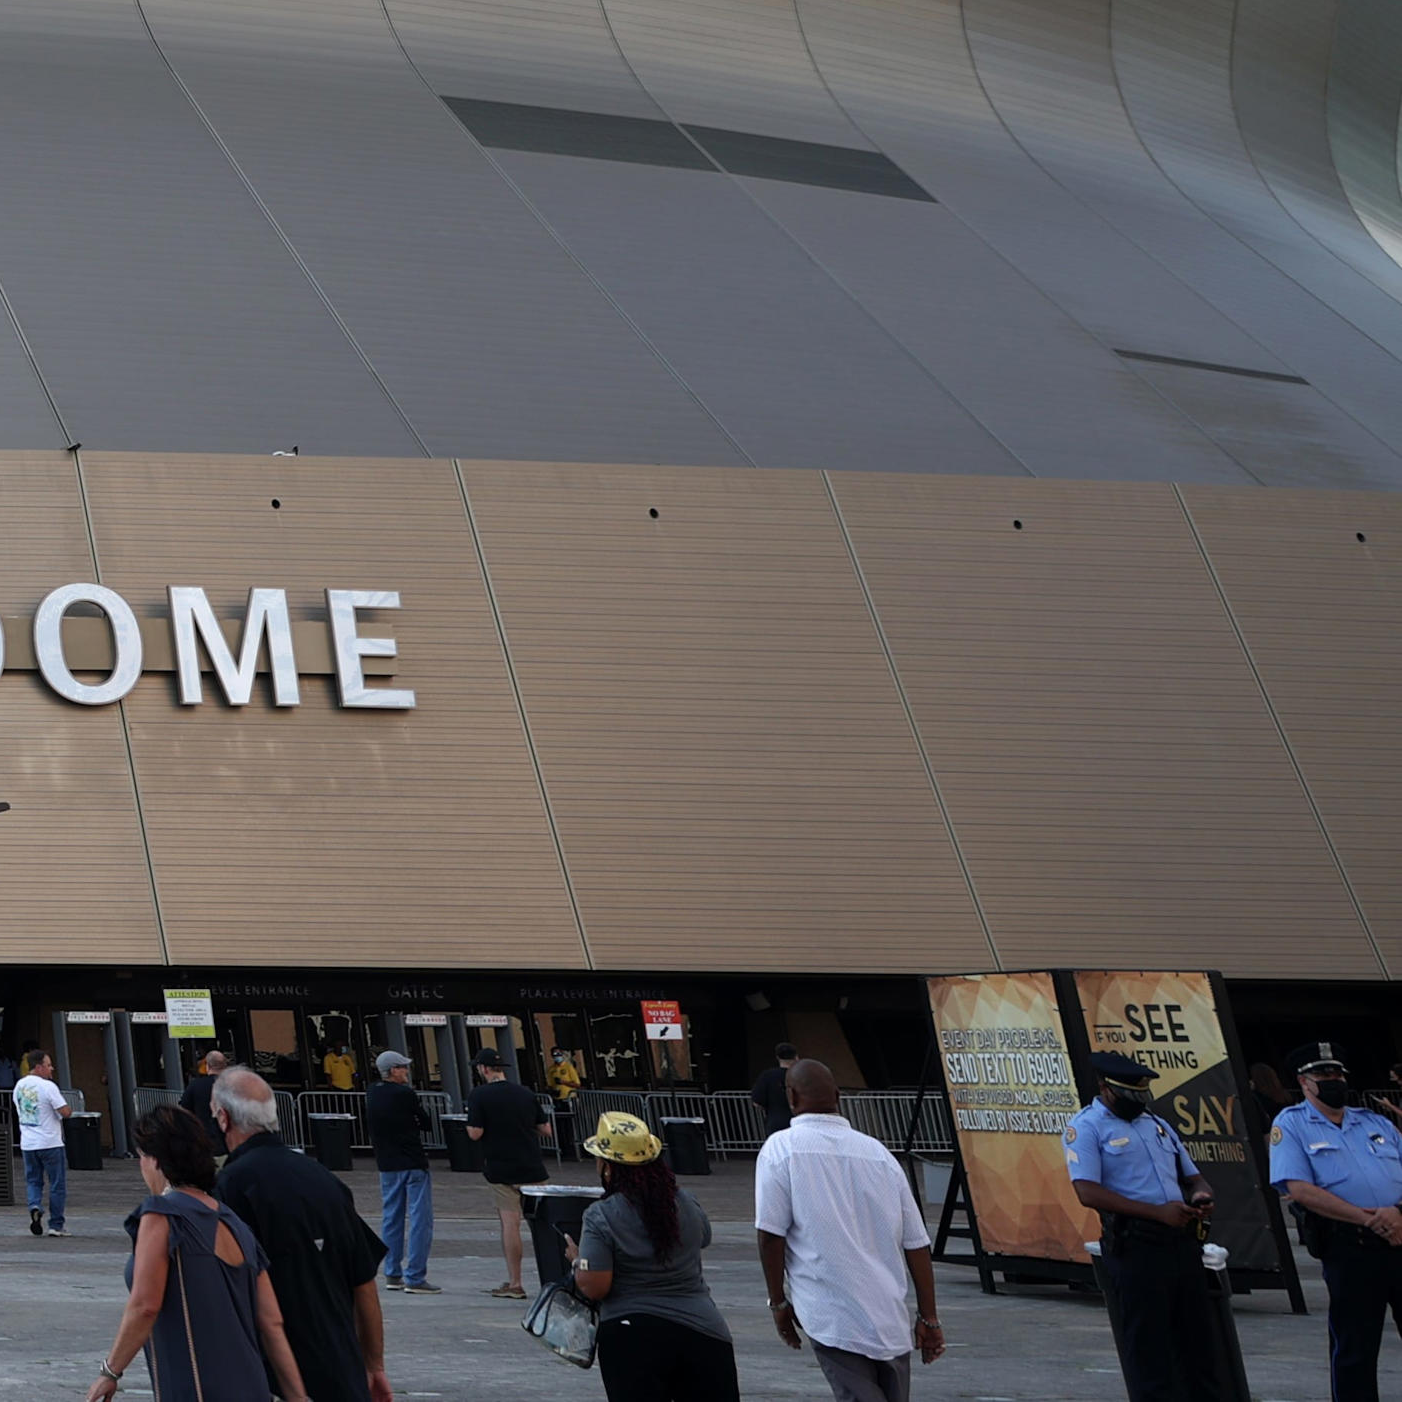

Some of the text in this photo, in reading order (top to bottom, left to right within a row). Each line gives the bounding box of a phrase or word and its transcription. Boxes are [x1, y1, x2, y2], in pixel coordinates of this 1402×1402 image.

[205, 984, 241, 996] EVEL
[245, 984, 312, 996] ENTRANCE
[387, 984, 445, 999] GATE C
[519, 988, 559, 999] PLAZA
[562, 988, 598, 999] LEVEL
[1094, 1004, 1190, 1043] IF YOU SEE
[941, 1029, 974, 1049] EVENT
[975, 1029, 997, 1049] DAY
[945, 1052, 1070, 1085] SEND TEXT TO 69050
[1015, 1090, 1041, 1106] NOLA
[955, 1109, 998, 1131] FOLLOWED
[995, 1109, 1008, 1132] BY
[1006, 1110, 1035, 1132] ISSUE
[1173, 1095, 1237, 1136] SAY
